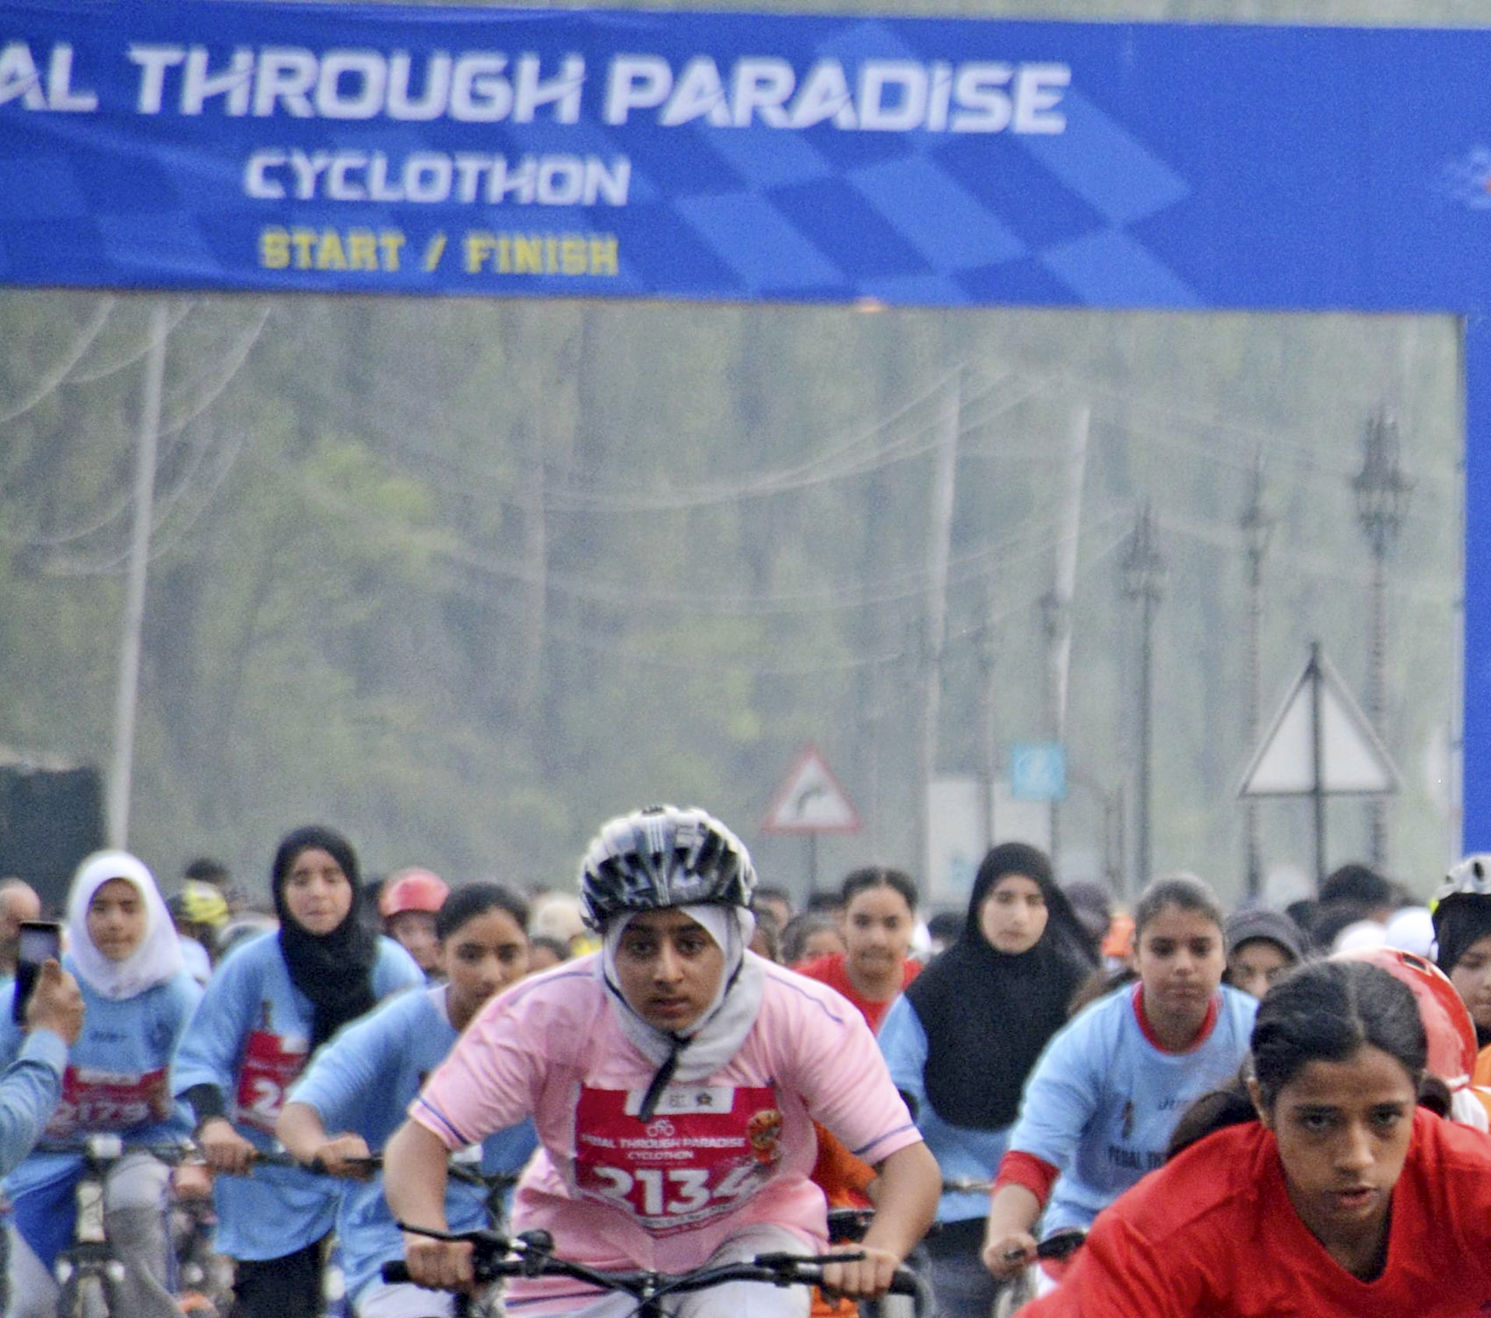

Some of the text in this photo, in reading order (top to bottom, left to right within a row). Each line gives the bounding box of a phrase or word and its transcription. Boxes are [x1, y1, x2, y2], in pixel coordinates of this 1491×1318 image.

[129, 44, 586, 127] THROUGH
[605, 55, 1072, 135] PARADISE
[244, 147, 631, 207] CYCLOTHON
[260, 231, 620, 276] START / FINISH
